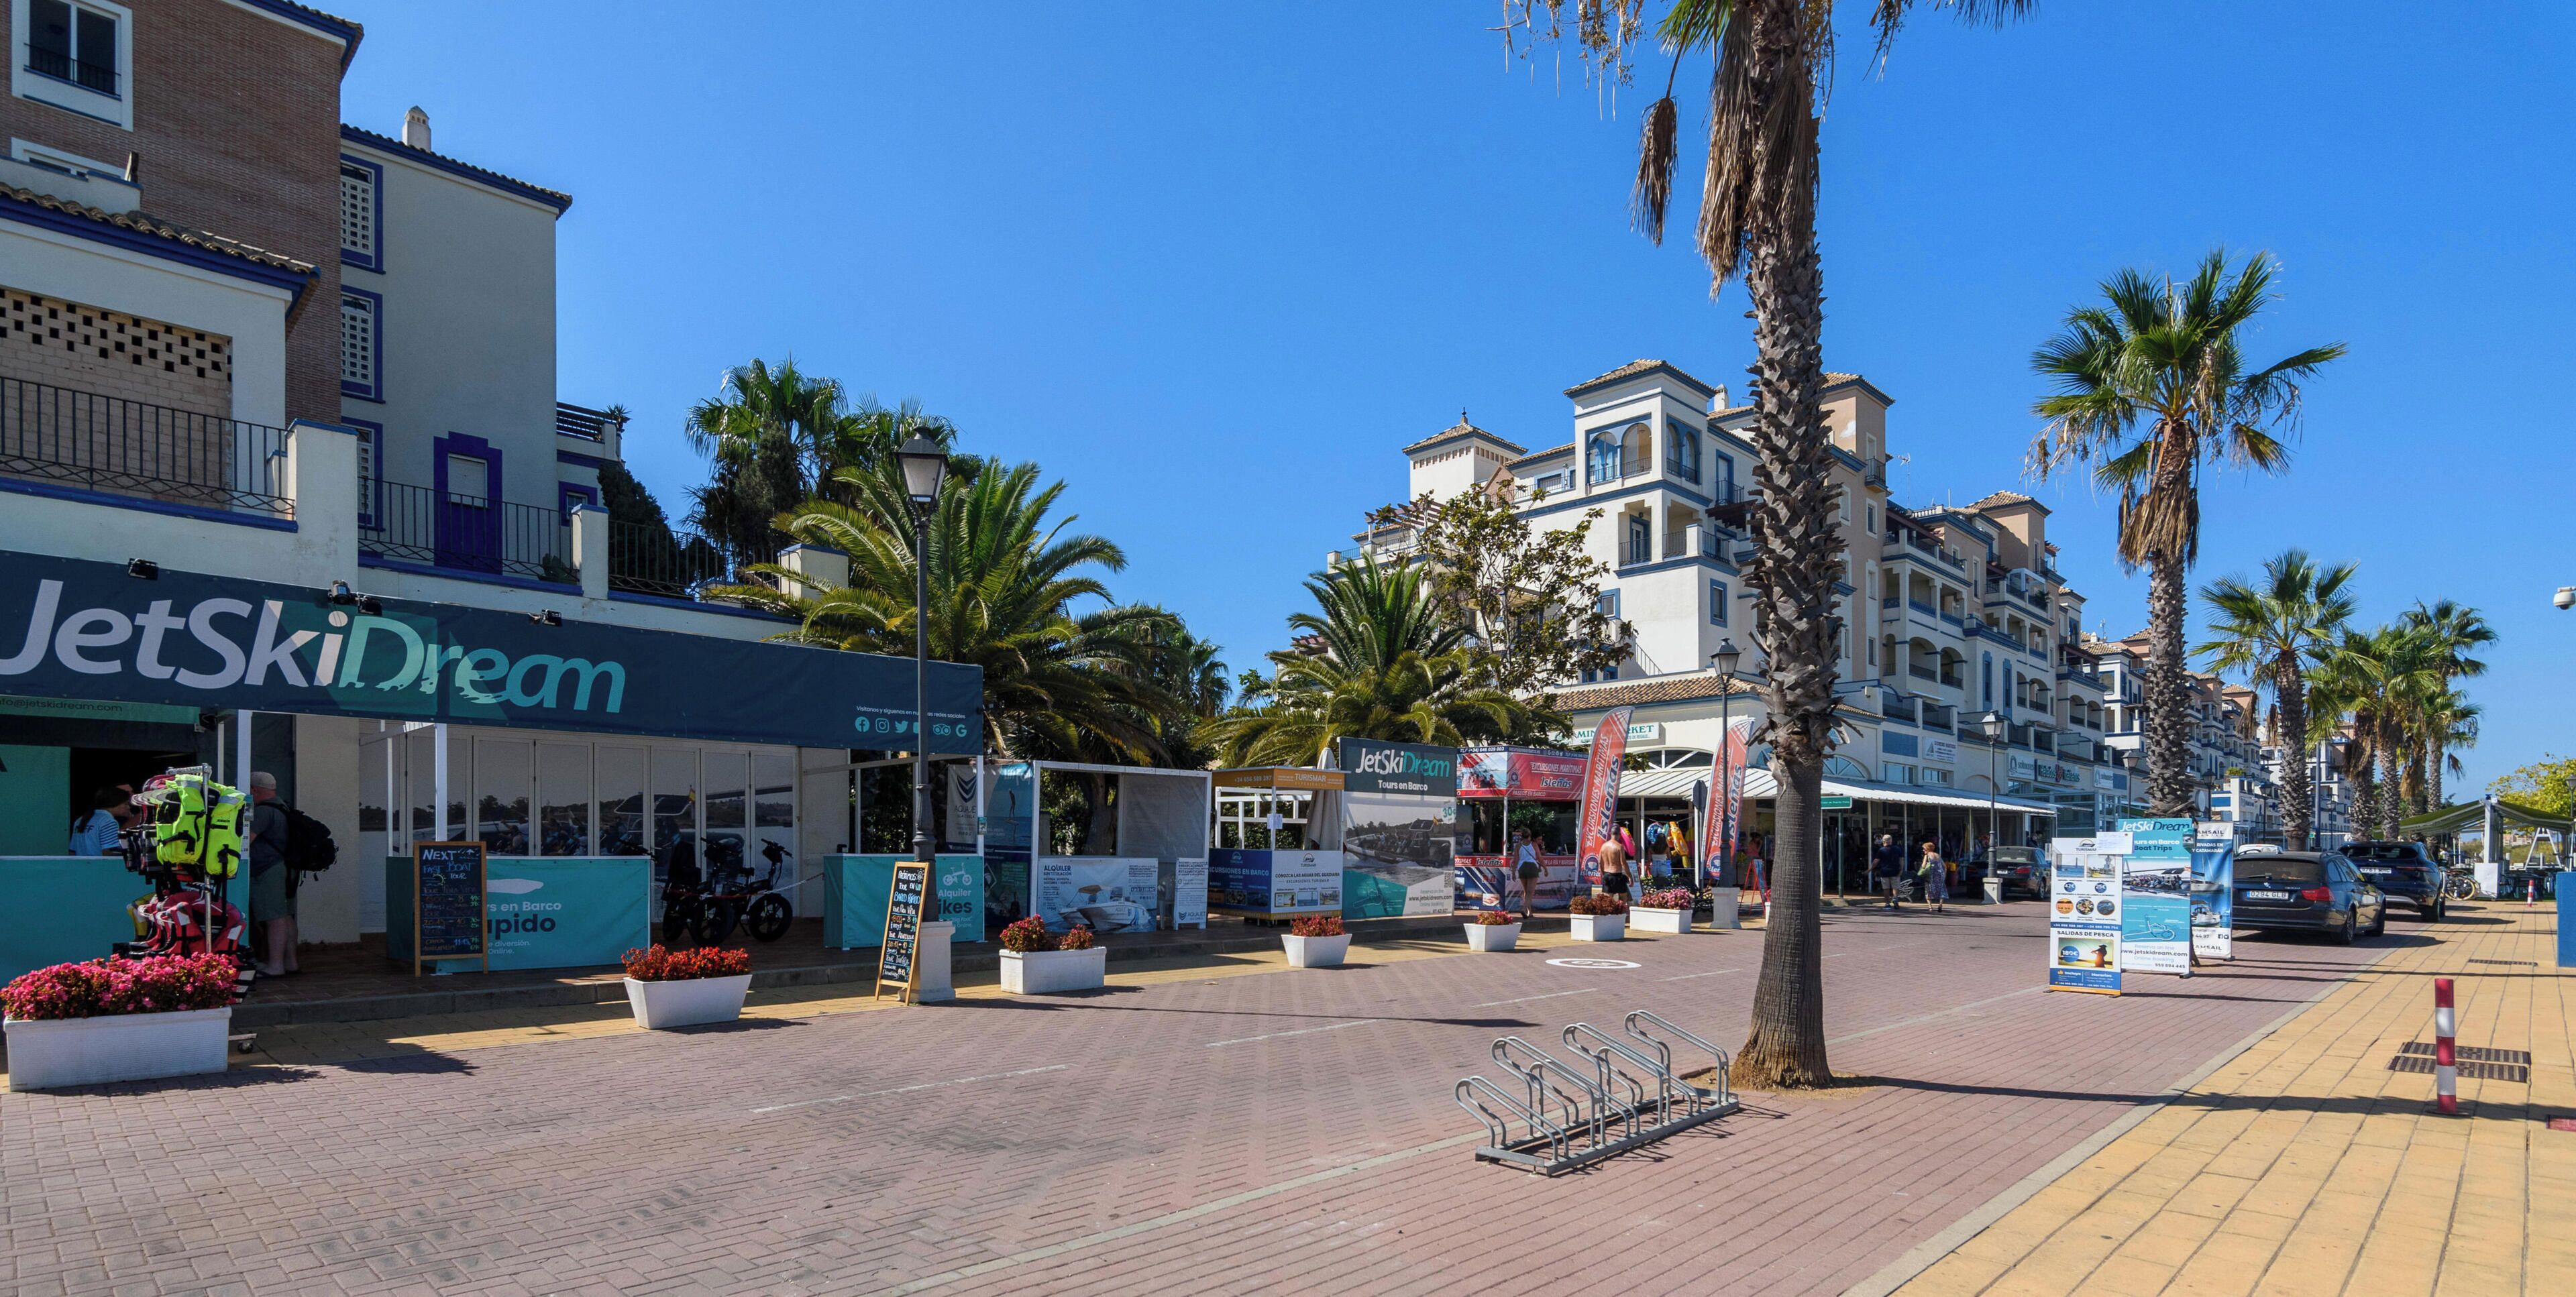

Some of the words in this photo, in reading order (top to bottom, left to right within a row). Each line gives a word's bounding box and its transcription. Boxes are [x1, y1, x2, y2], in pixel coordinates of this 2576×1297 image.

[0, 579, 625, 714] JetSkiDream
[1577, 729, 1596, 738] MIN
[1356, 748, 1450, 777] JetSkiDream
[1530, 761, 1558, 771] EXCURSIONES
[1295, 773, 1326, 782] TURISMAR
[1378, 780, 1400, 789] Tours
[1409, 782, 1428, 791] Barco
[1585, 789, 1600, 848] EXCURSIONES
[2120, 821, 2190, 832] JetSkiDream
[423, 849, 457, 860] NEXT
[447, 860, 476, 872] BOAT
[1208, 866, 1241, 875] CURSIONES
[938, 889, 972, 899] Alquiler
[500, 903, 519, 911] en
[523, 901, 561, 911] Barco
[938, 899, 973, 914] ikes
[487, 913, 556, 940] pido
